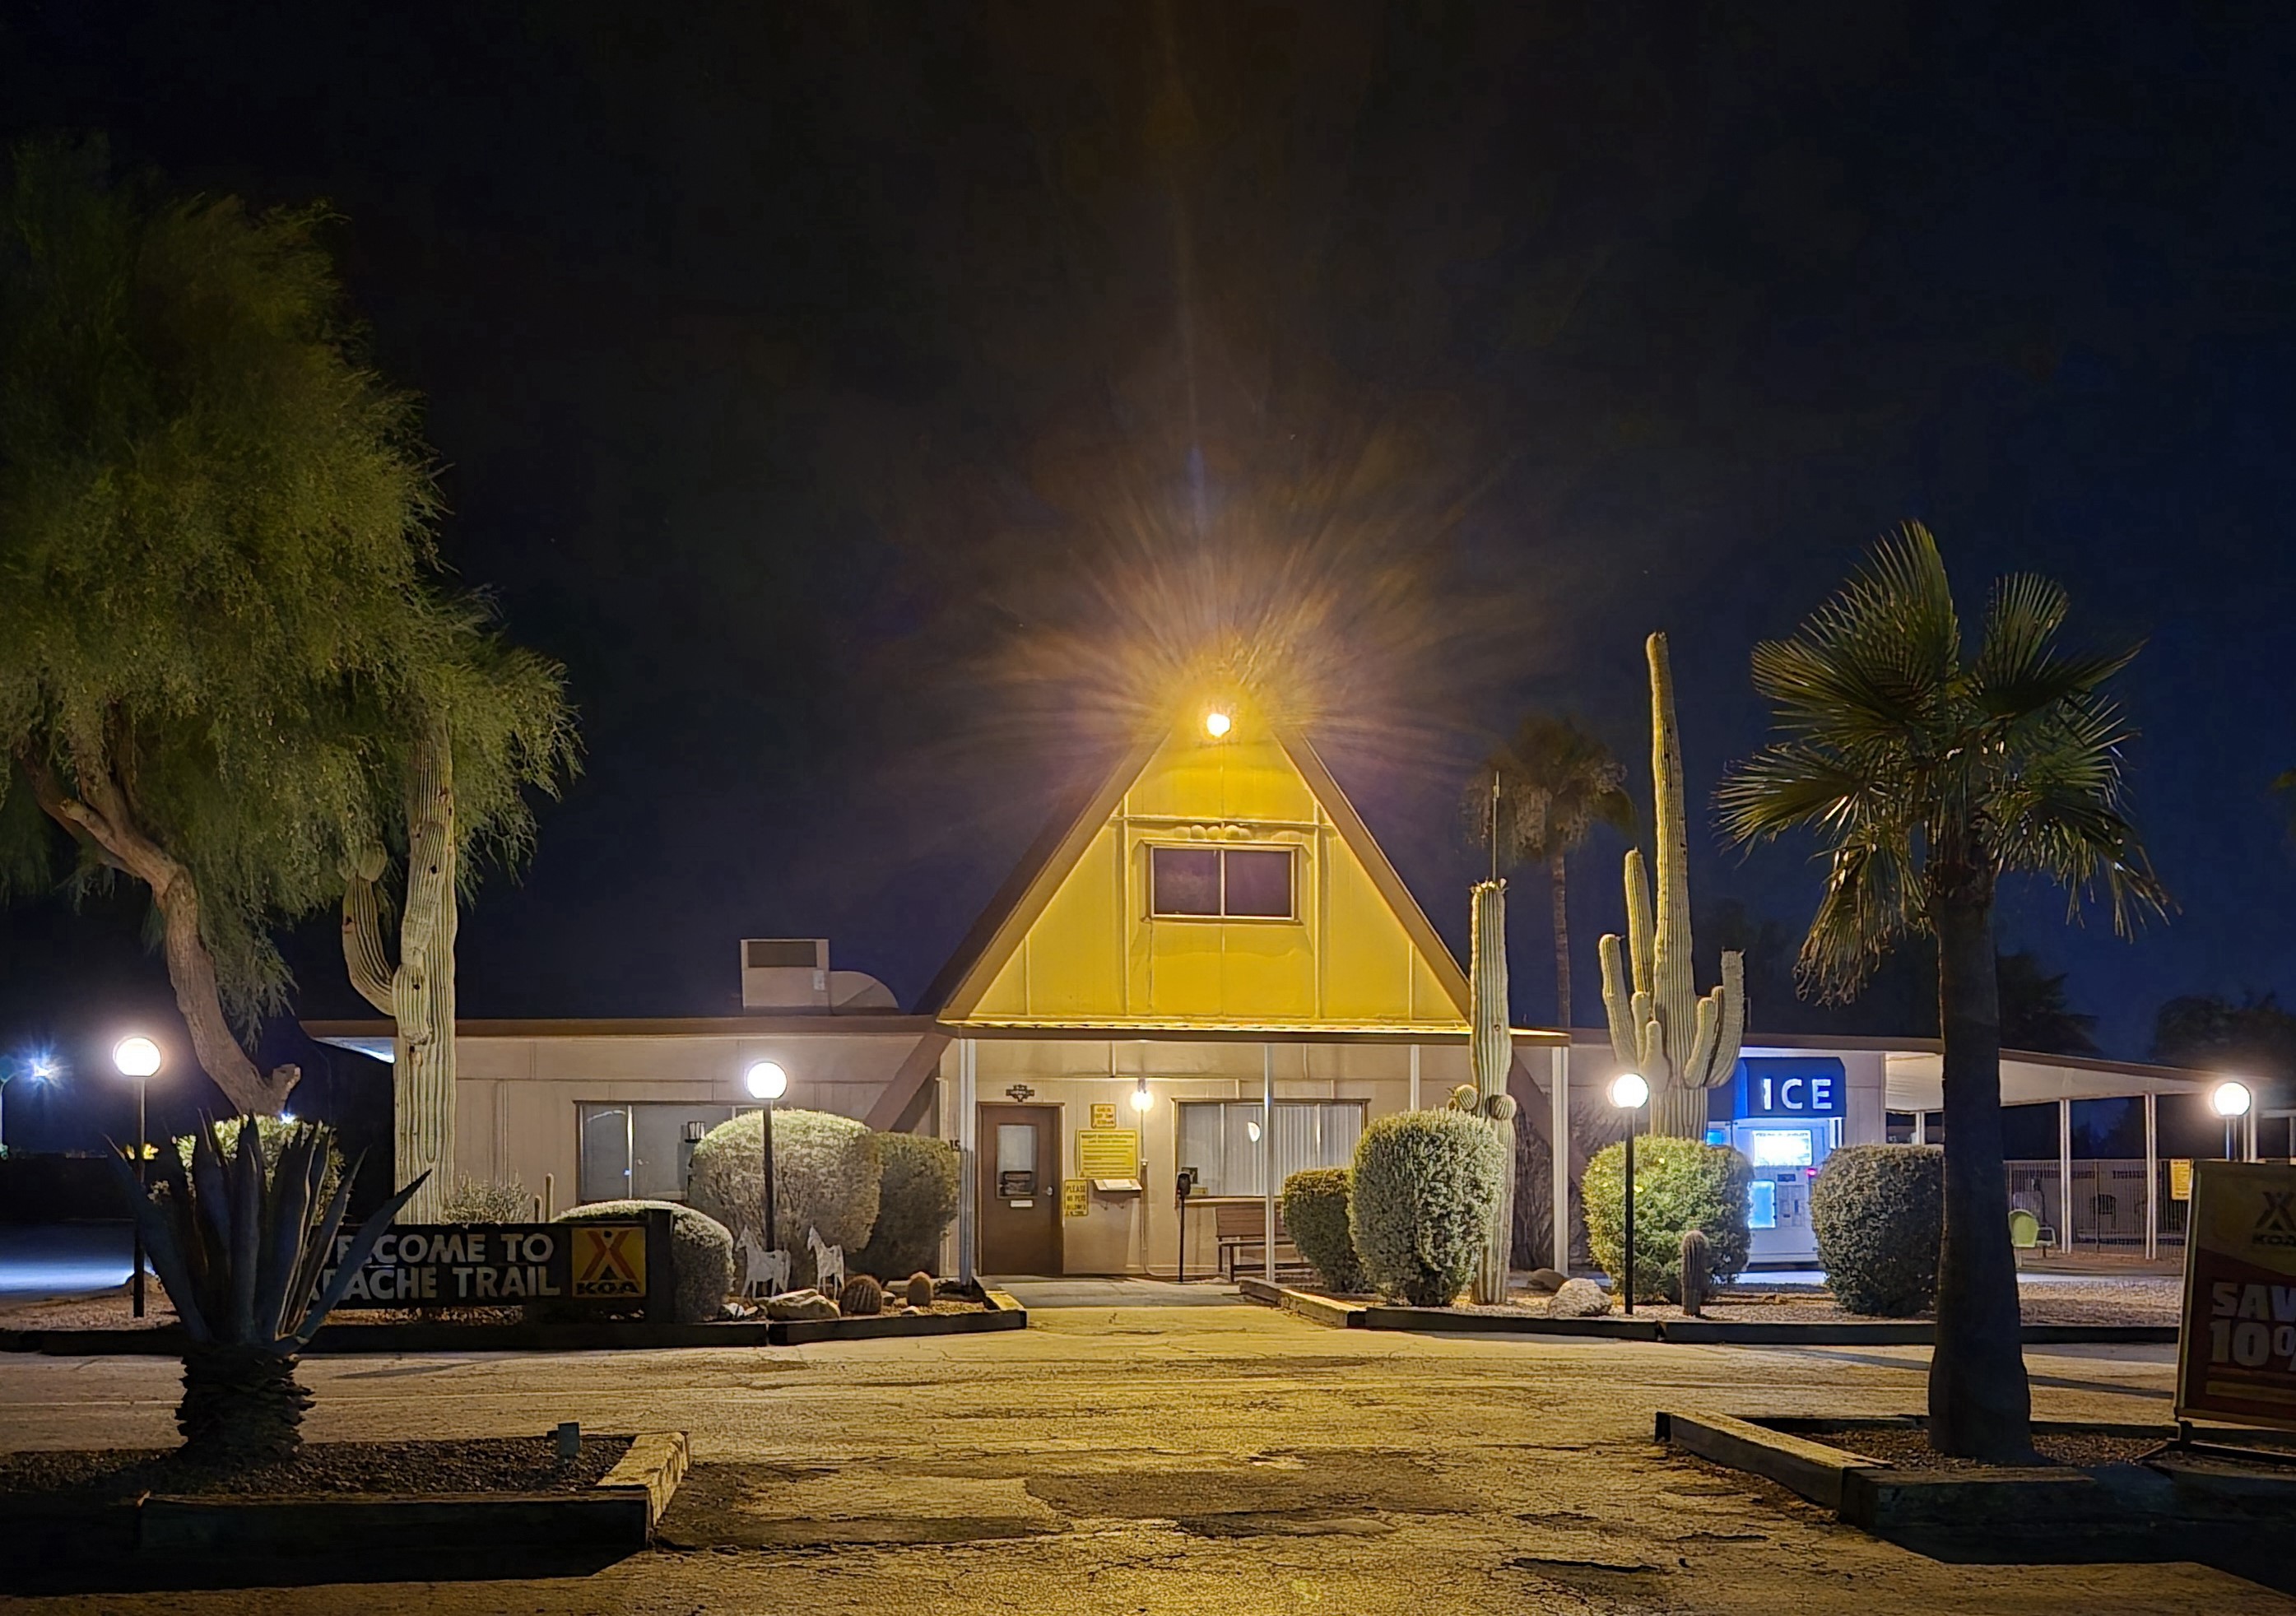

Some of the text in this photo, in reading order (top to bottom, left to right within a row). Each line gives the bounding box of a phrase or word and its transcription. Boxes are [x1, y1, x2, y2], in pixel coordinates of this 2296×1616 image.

[1763, 1078, 1833, 1110] ICE
[1067, 1185, 1085, 1193] PLEASE
[337, 1233, 554, 1263] ECOME TO
[311, 1265, 560, 1300] ACHE TRAIL
[577, 1281, 639, 1294] KOA
[2211, 1281, 2296, 1322] SAV
